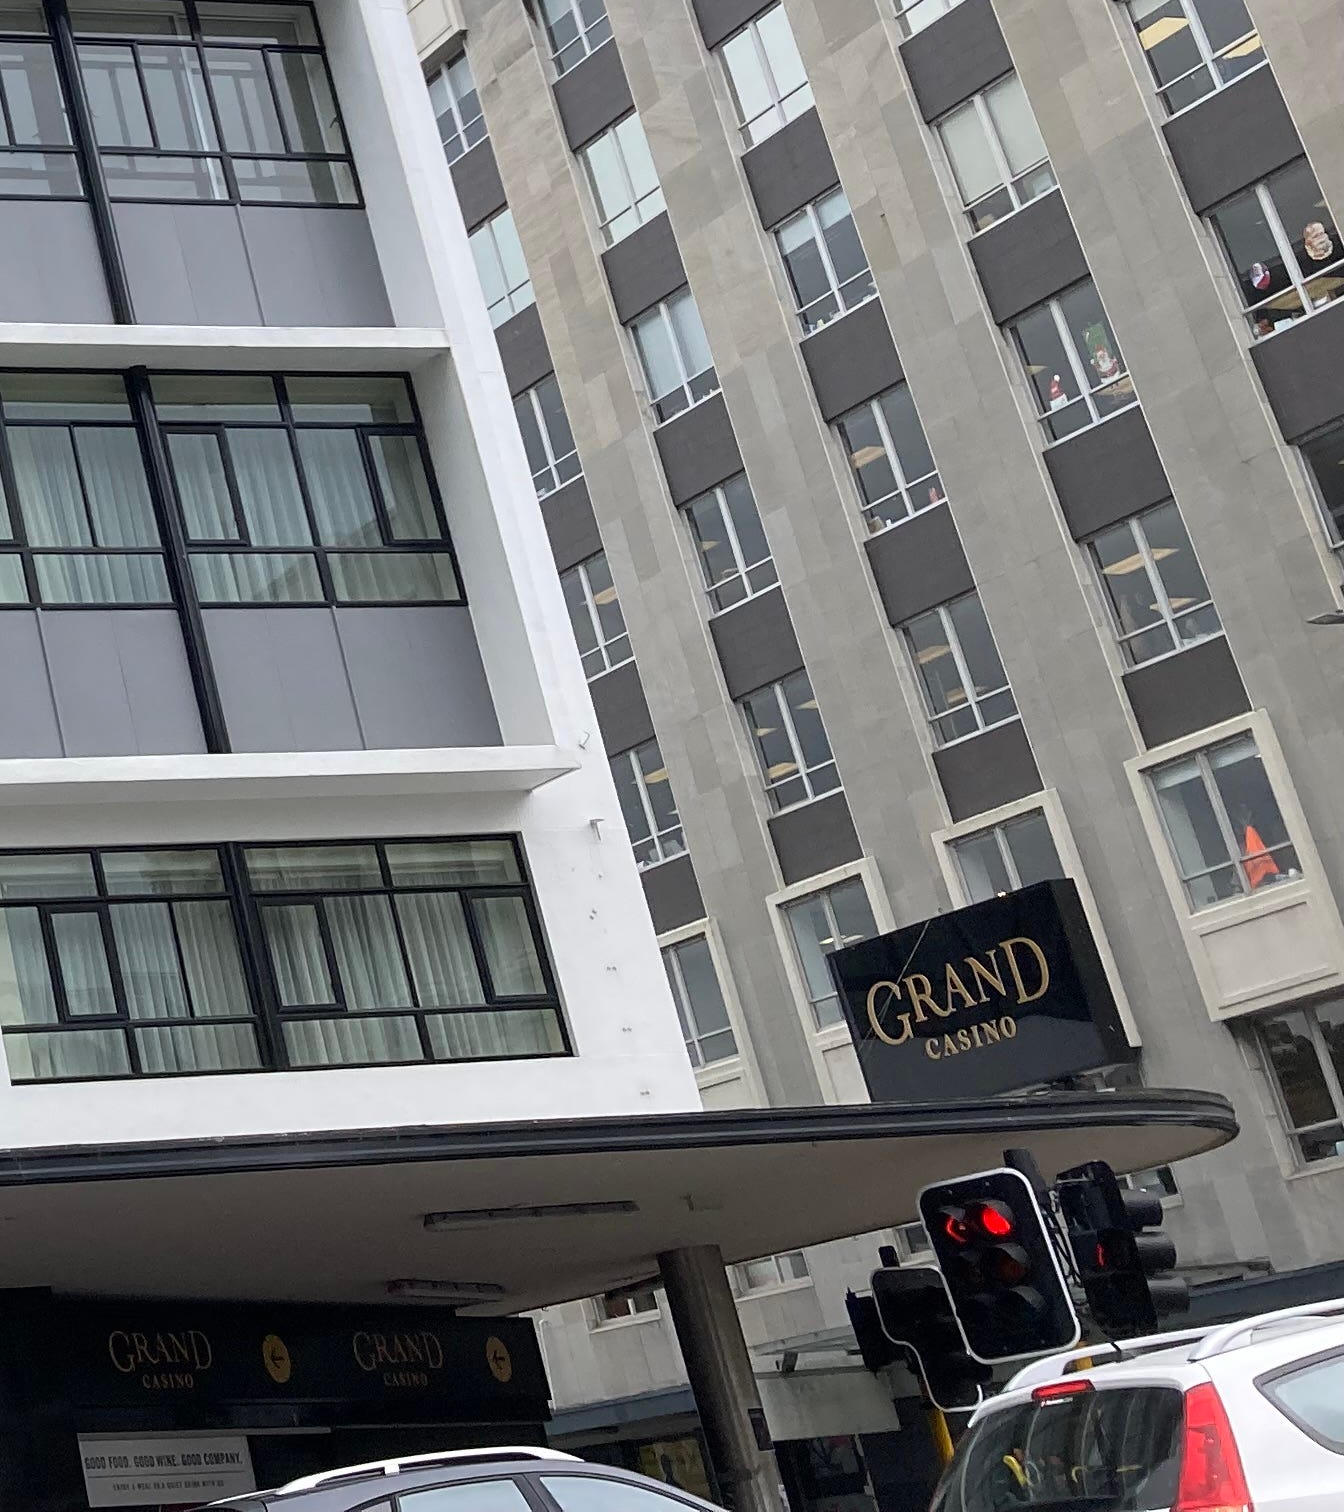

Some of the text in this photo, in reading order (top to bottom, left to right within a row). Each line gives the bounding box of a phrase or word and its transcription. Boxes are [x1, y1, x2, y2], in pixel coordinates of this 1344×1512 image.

[866, 936, 1050, 1046] GRAND
[924, 1015, 1017, 1060] CASINO
[108, 1330, 212, 1373] GRAND
[352, 1331, 444, 1372] GRAND
[142, 1373, 194, 1390] CASINO
[383, 1372, 429, 1388] CASINO
[84, 1456, 107, 1470] GOOD
[133, 1455, 155, 1468] GOOD
[181, 1453, 202, 1466] GOOD
